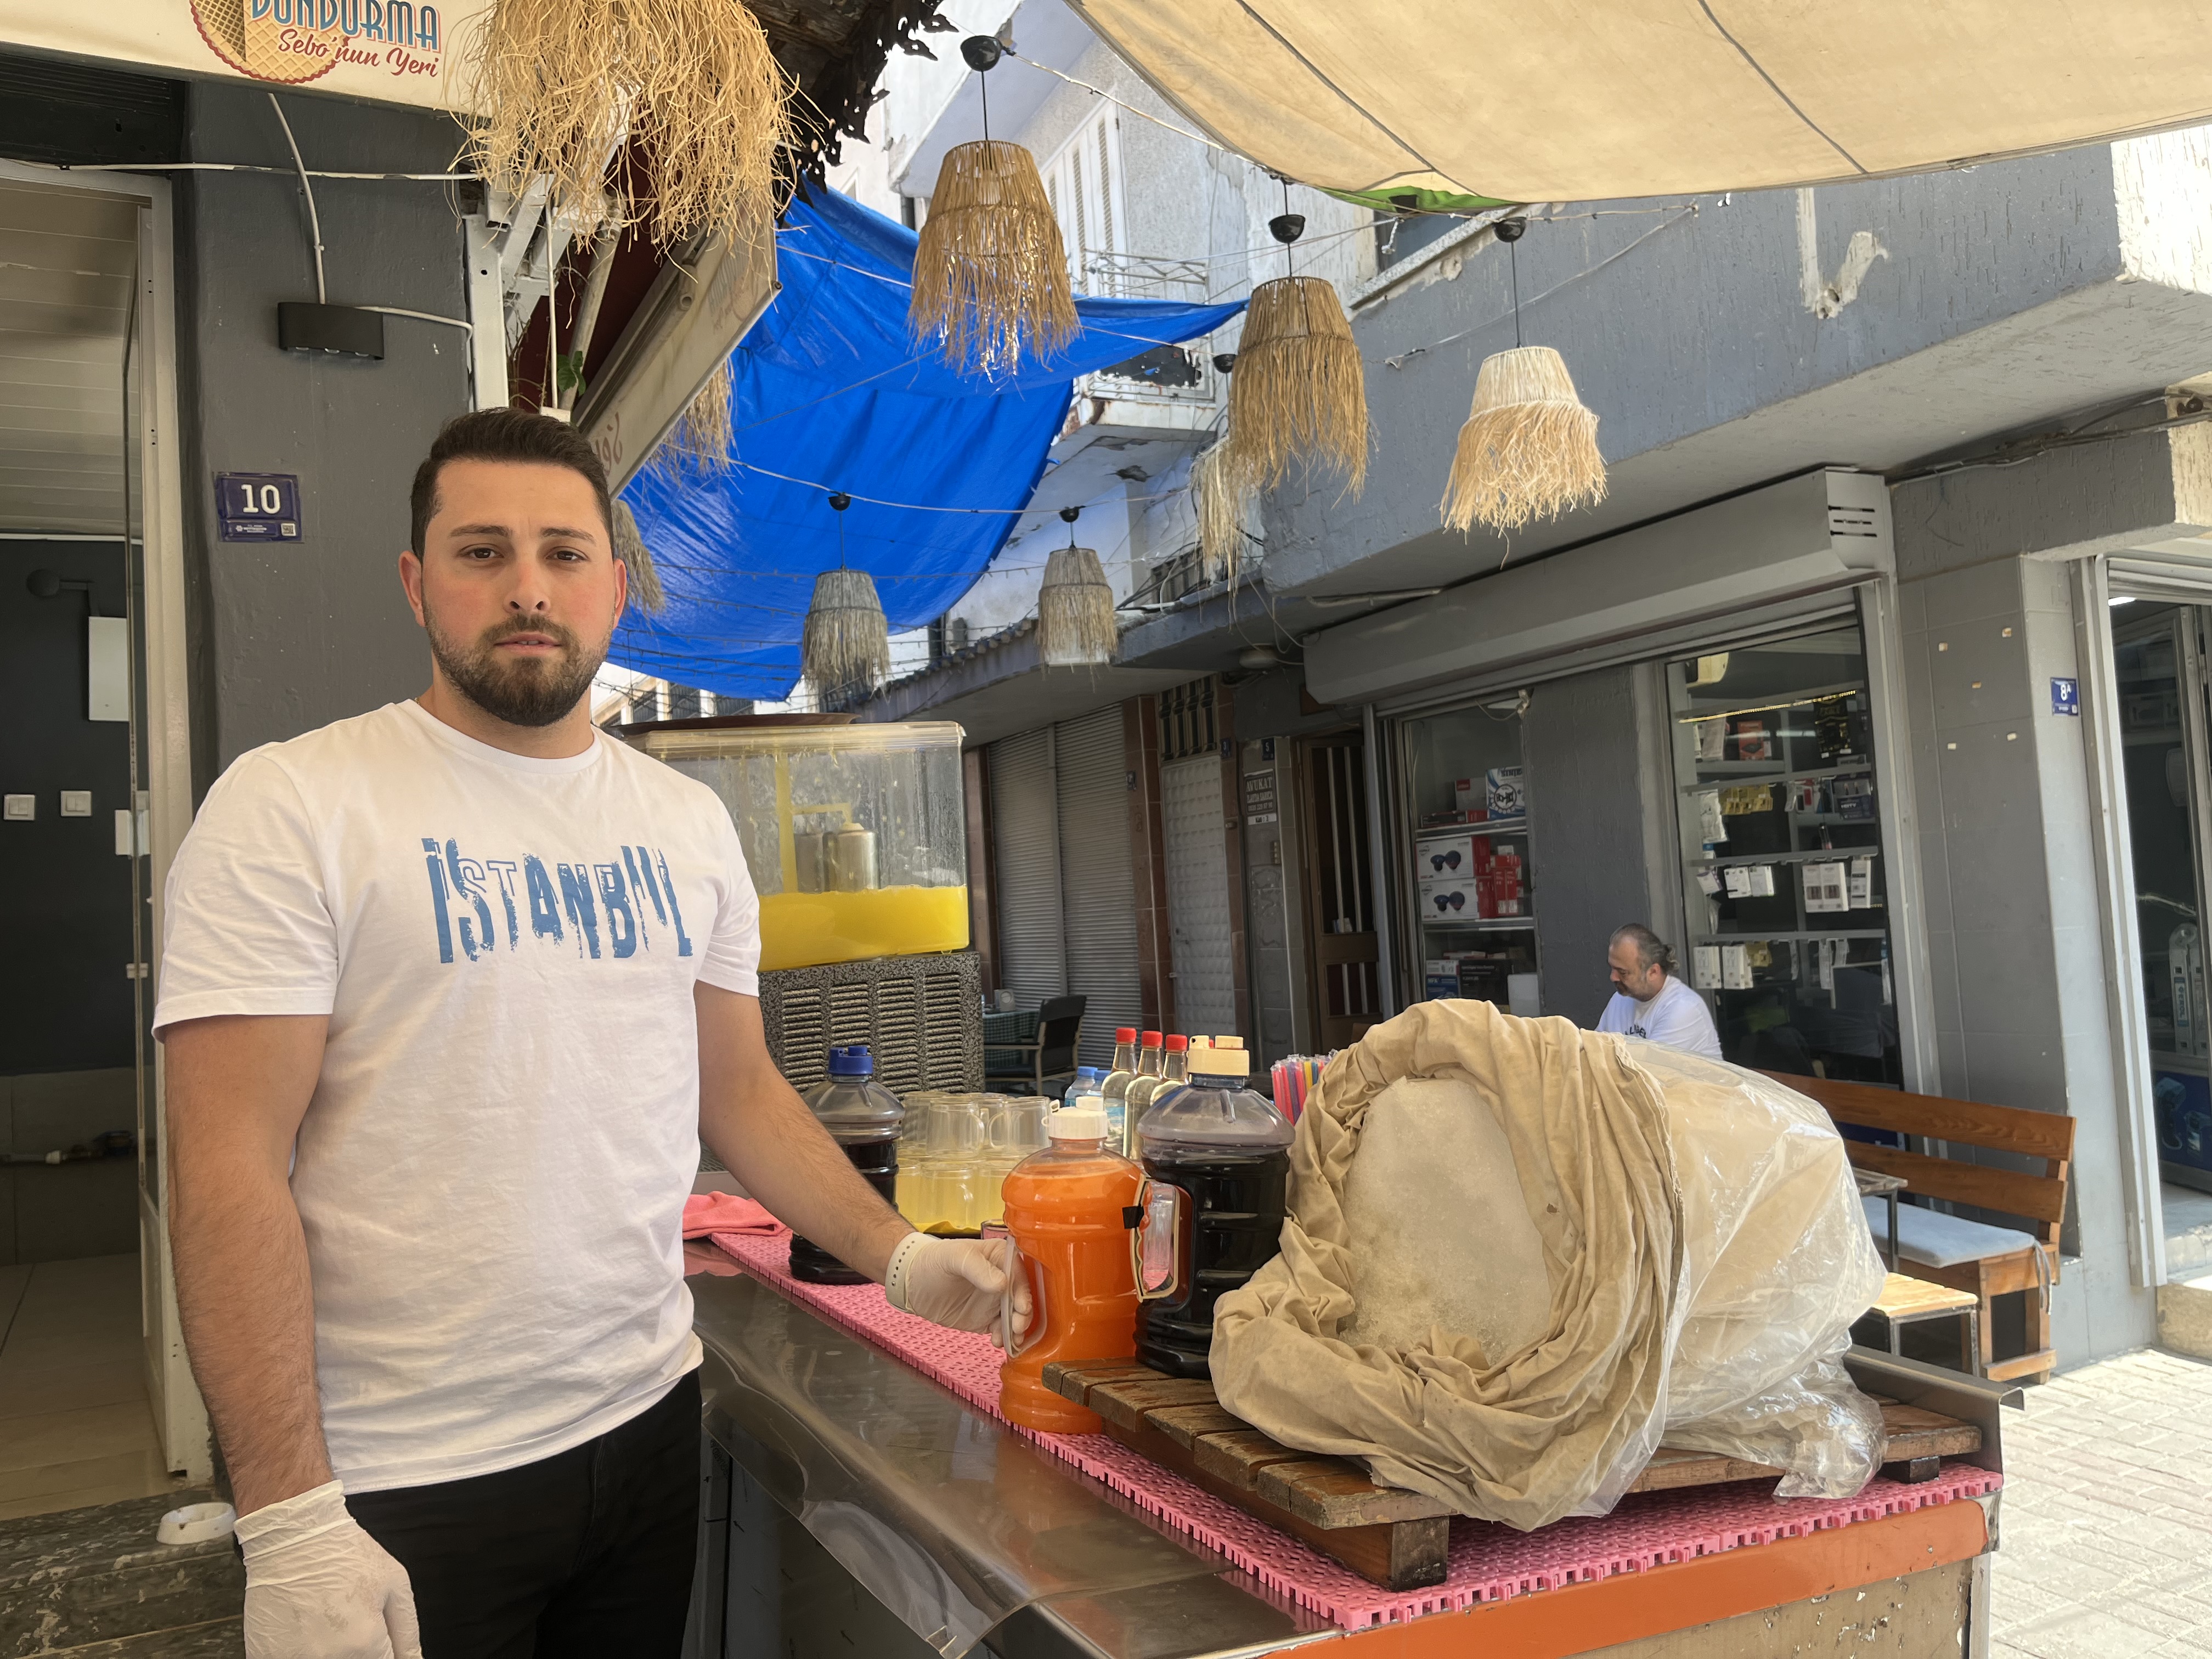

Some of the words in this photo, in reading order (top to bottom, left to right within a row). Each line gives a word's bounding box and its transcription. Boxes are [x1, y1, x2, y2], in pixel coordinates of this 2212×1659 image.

[278, 29, 380, 66] Sebo'nun
[386, 47, 439, 77] Yeri
[241, 484, 281, 514] 10
[1246, 777, 1272, 792] AVUKAT
